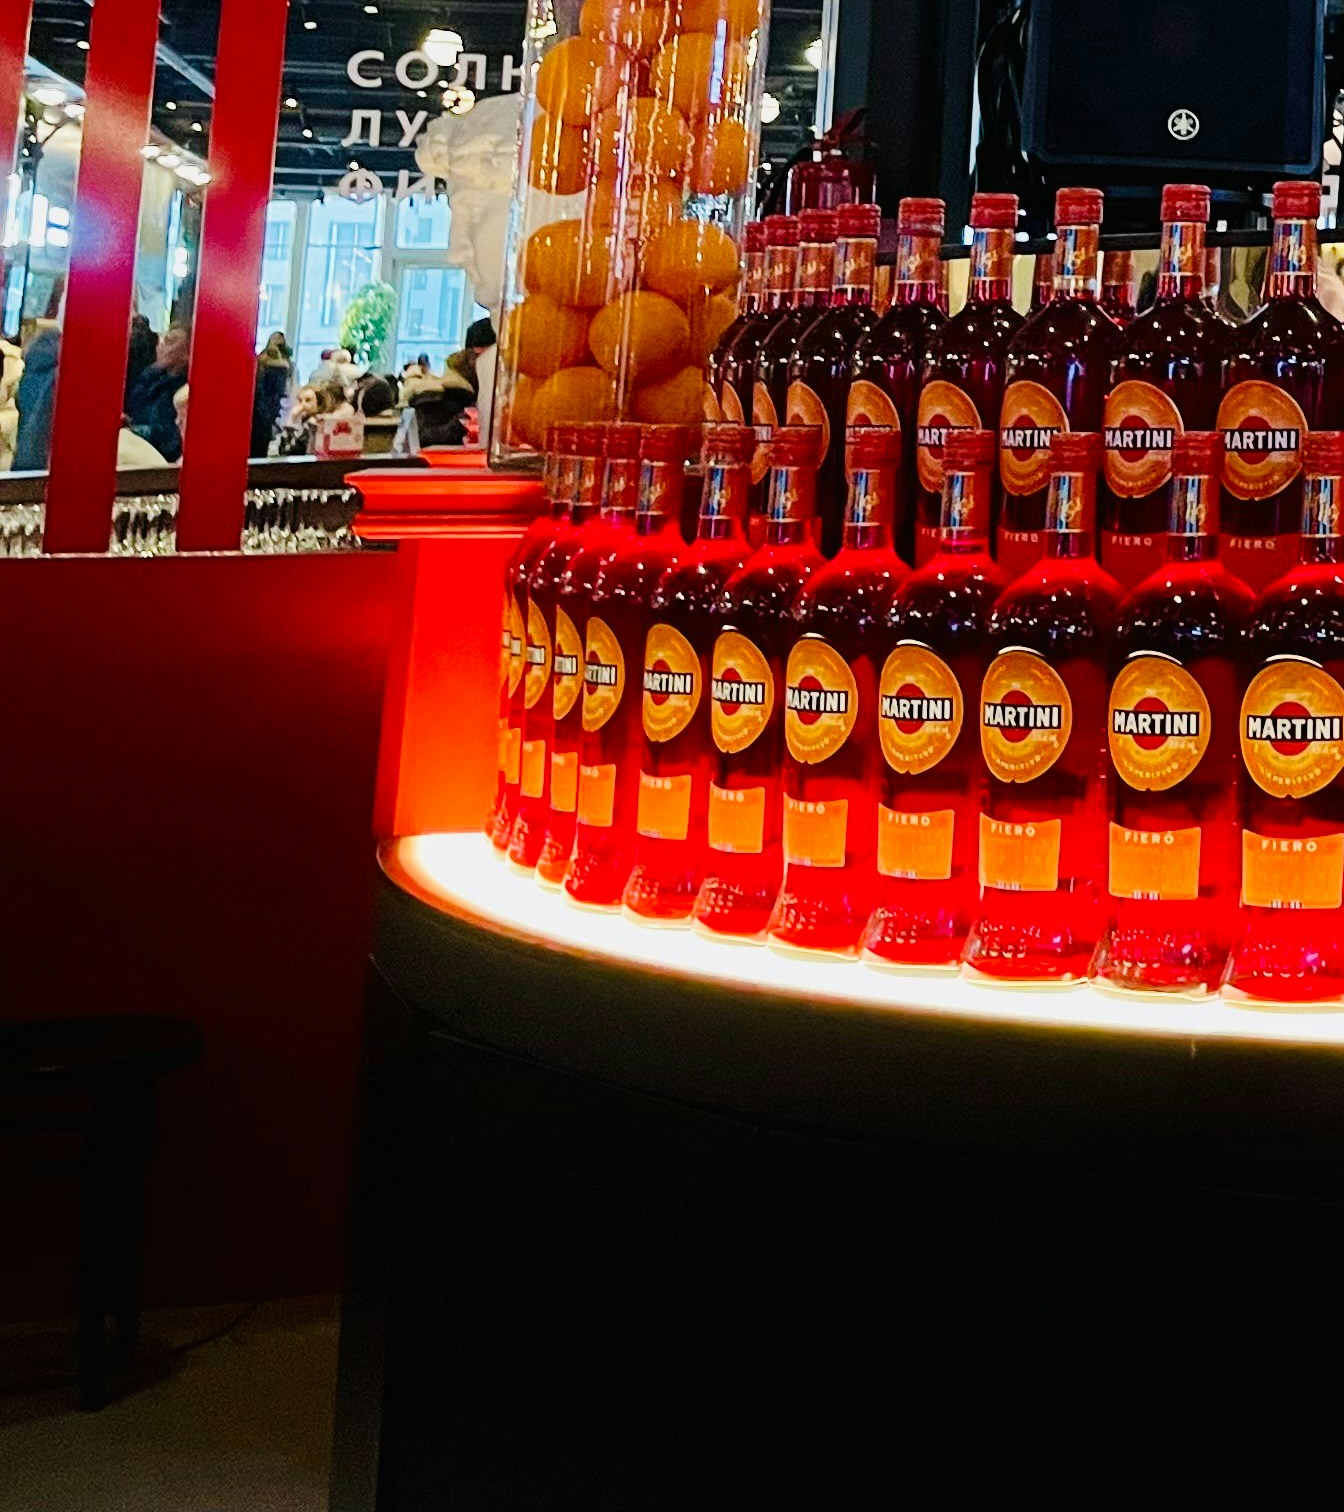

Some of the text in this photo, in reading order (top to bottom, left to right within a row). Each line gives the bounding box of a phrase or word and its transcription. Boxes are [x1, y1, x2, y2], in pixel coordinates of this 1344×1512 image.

[1001, 428, 1057, 447] MARTIN
[1105, 429, 1172, 448] MARTINI
[882, 696, 951, 719] MARTINI
[985, 704, 1059, 728] MARTINI
[1114, 711, 1197, 734] MARTINI
[1248, 717, 1340, 739] MARTINI
[1261, 839, 1318, 852] FIERO
